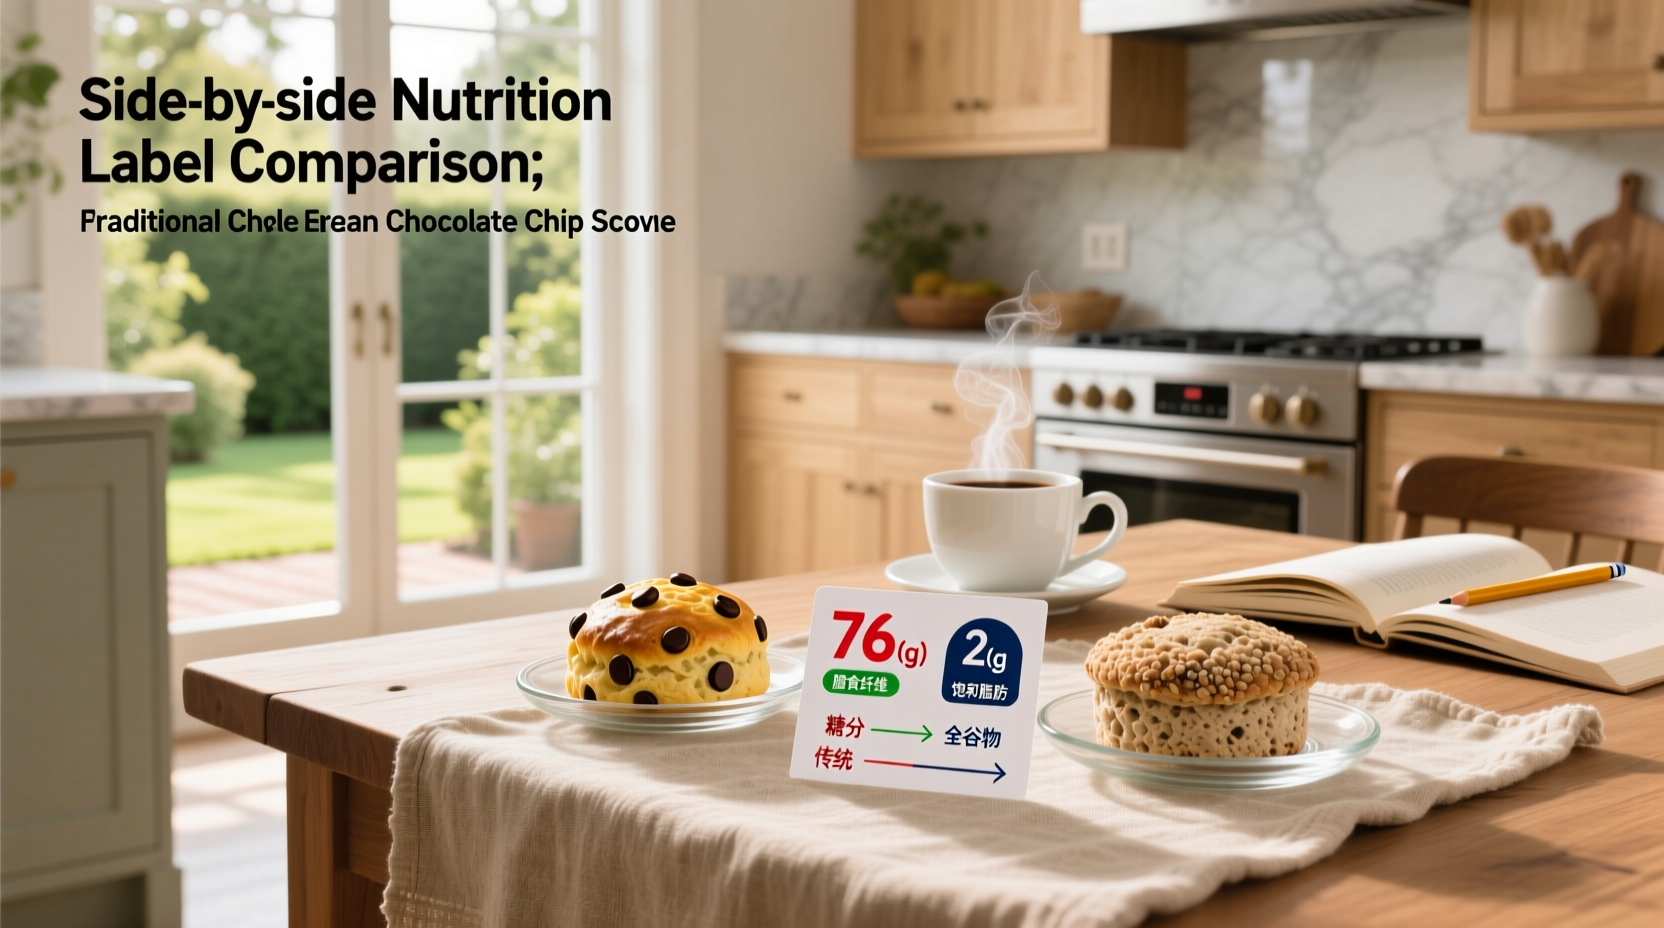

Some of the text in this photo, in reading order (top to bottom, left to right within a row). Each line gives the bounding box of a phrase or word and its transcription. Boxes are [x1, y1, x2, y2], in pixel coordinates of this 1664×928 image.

[825, 714, 865, 738] 糖分
[945, 725, 1001, 748] 全谷物
[815, 746, 853, 770] 传统
